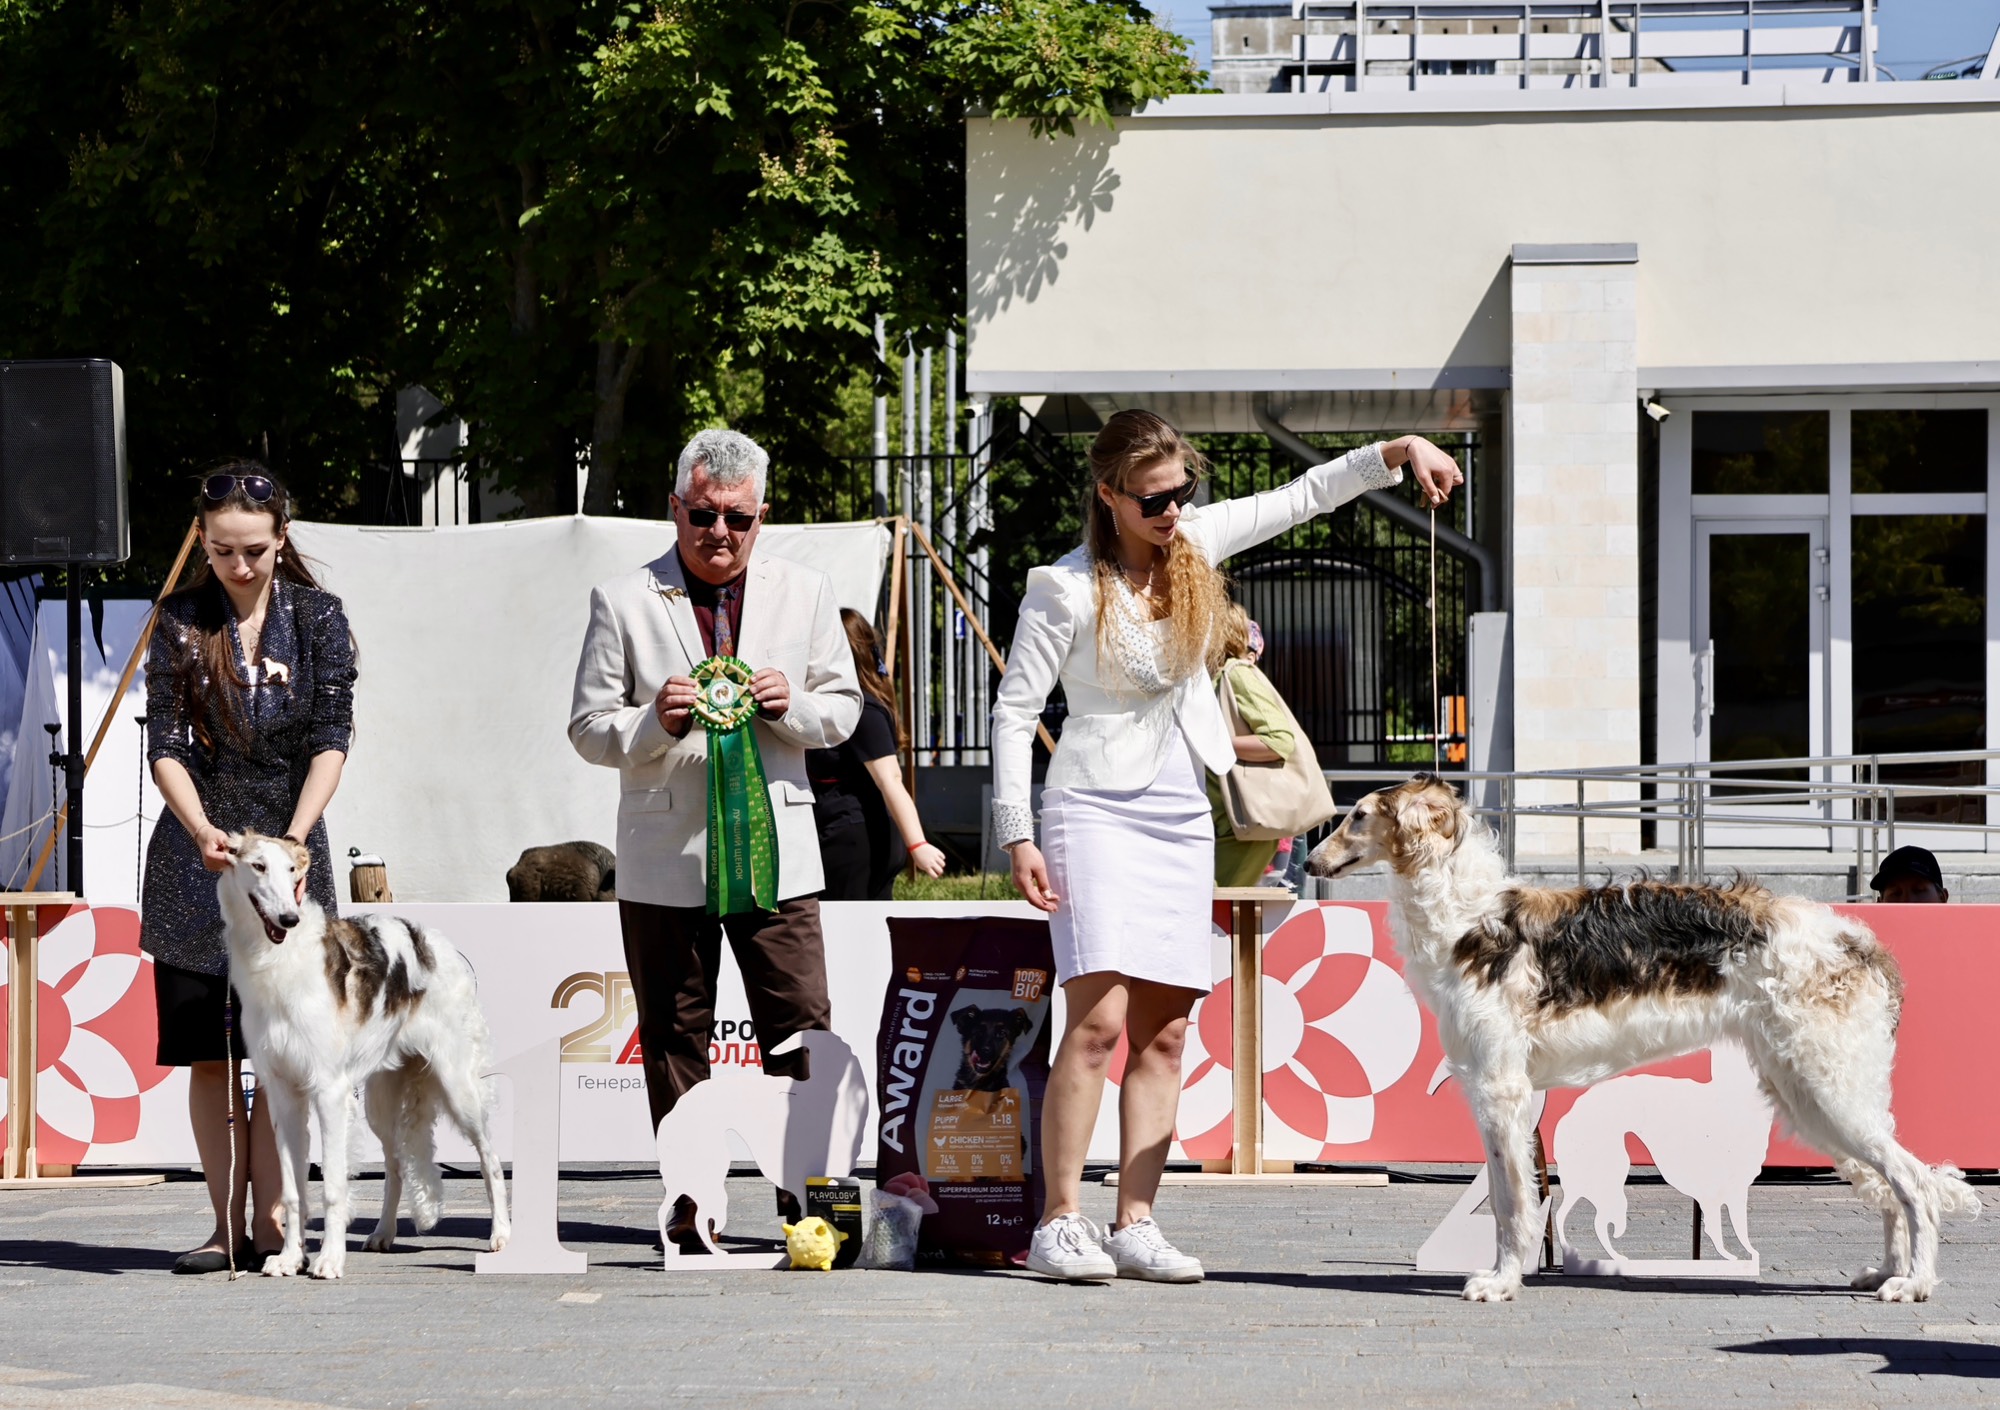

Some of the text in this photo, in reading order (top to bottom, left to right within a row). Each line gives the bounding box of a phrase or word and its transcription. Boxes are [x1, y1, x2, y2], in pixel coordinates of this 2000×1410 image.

[732, 808, 744, 880] ЛУЧШИЙ ЩЕНОК
[1016, 970, 1043, 985] 100%
[1014, 983, 1040, 998] BIO
[884, 1001, 903, 1050] CHAMPIONS
[881, 988, 937, 1154] Award
[938, 1095, 963, 1103] LARGE
[934, 1116, 960, 1124] PUPPY
[991, 1114, 1012, 1125] 1-18
[949, 1136, 984, 1144] CHICKEN
[940, 1154, 956, 1165] 74%
[971, 1154, 983, 1165] 0%
[1000, 1154, 1012, 1165] 0%
[809, 1191, 856, 1200] PLAYOLOGY
[986, 1214, 1000, 1225] 12
[1002, 1218, 1012, 1226] kg
